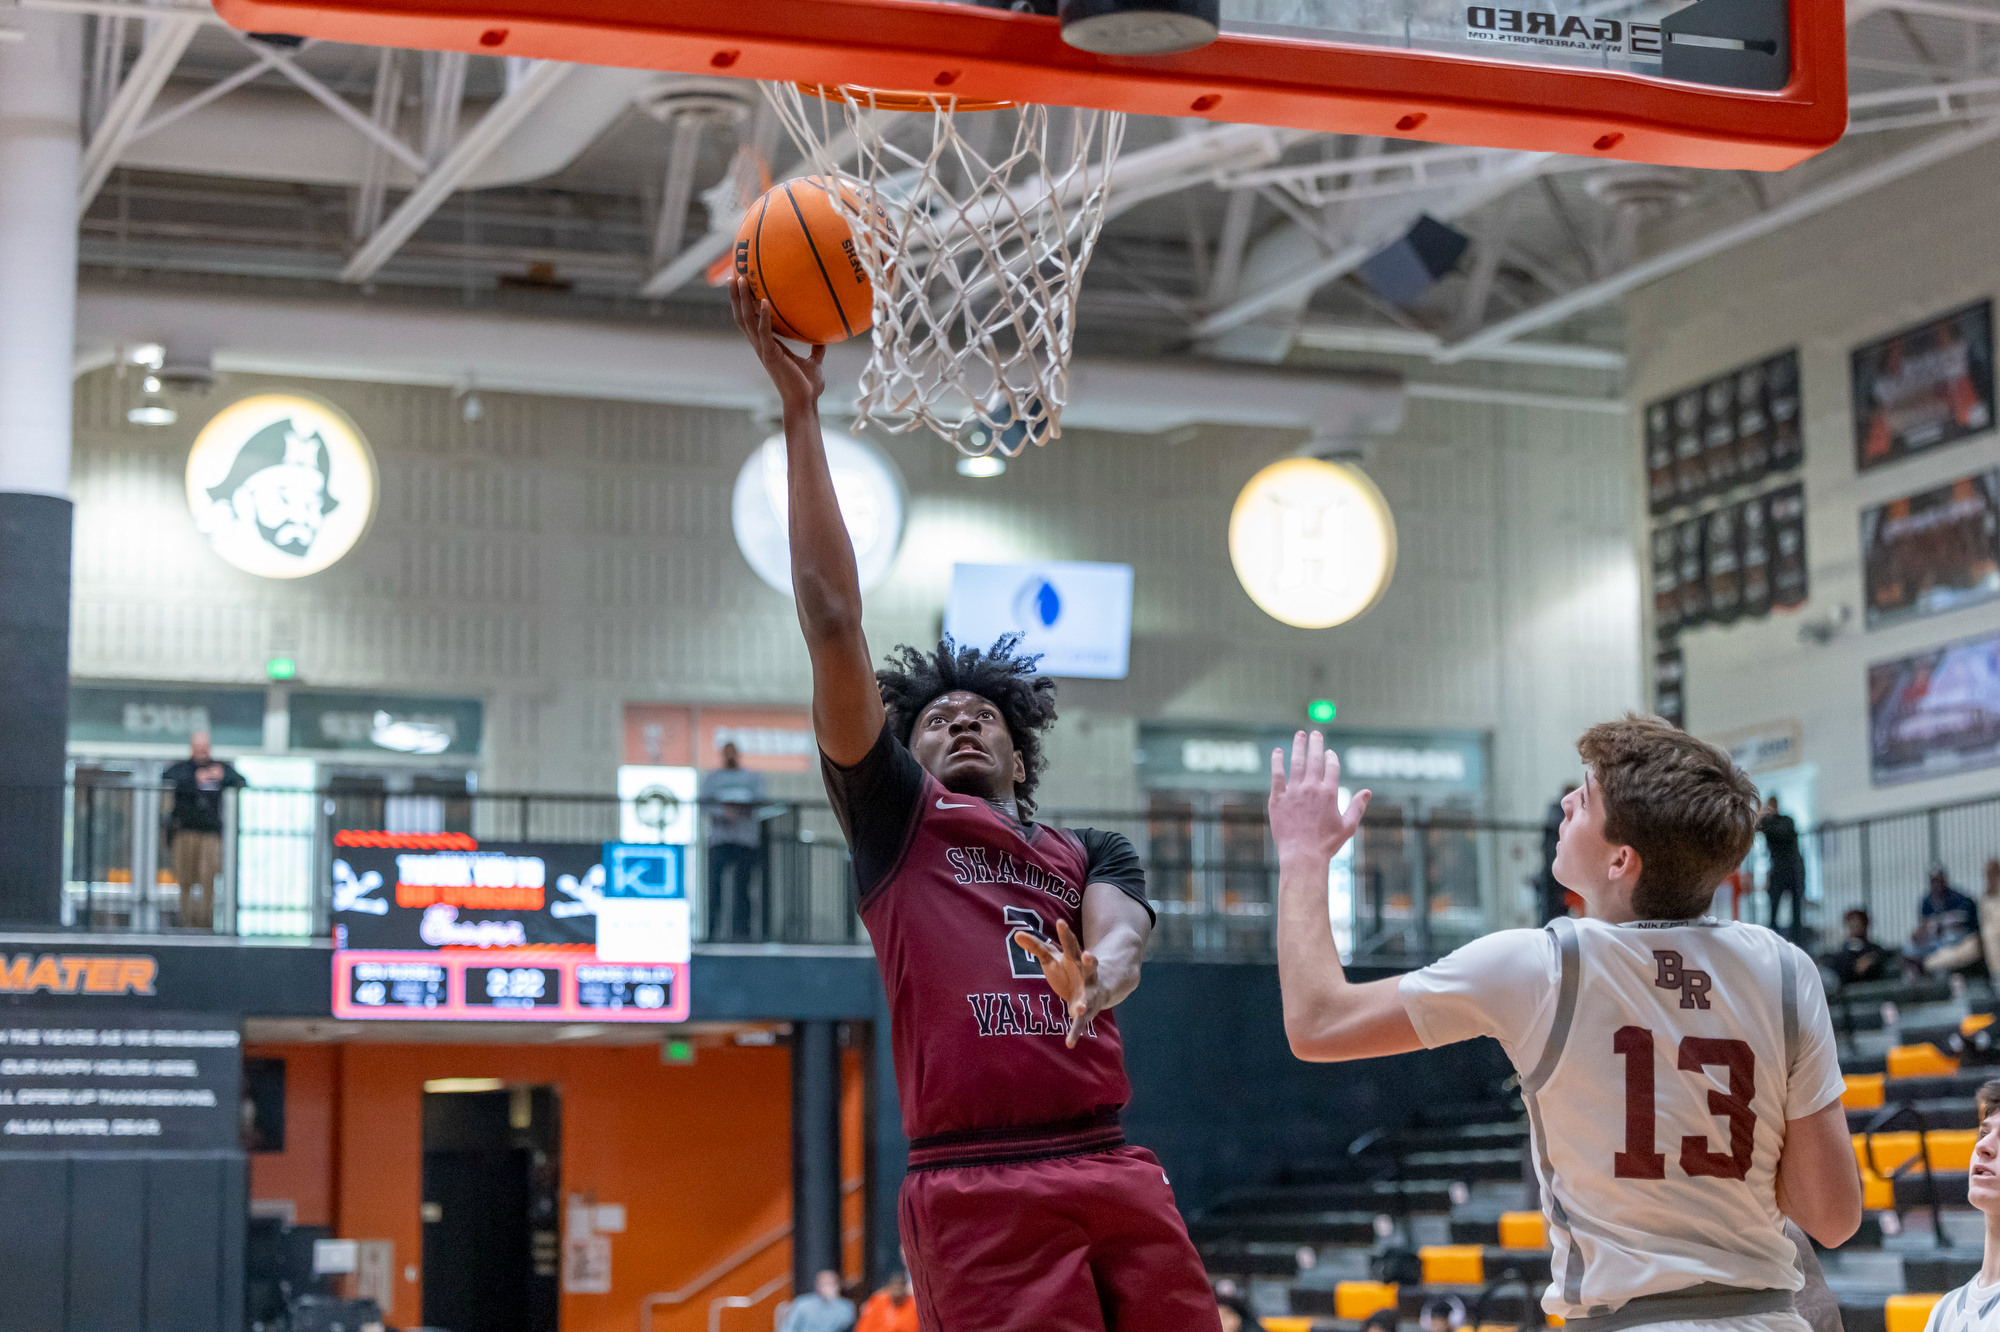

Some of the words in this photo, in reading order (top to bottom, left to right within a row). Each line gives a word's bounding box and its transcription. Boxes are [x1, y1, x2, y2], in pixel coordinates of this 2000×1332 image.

[0, 954, 158, 995] MATER
[1003, 905, 1052, 979] 2
[1614, 1025, 1757, 1181] 13
